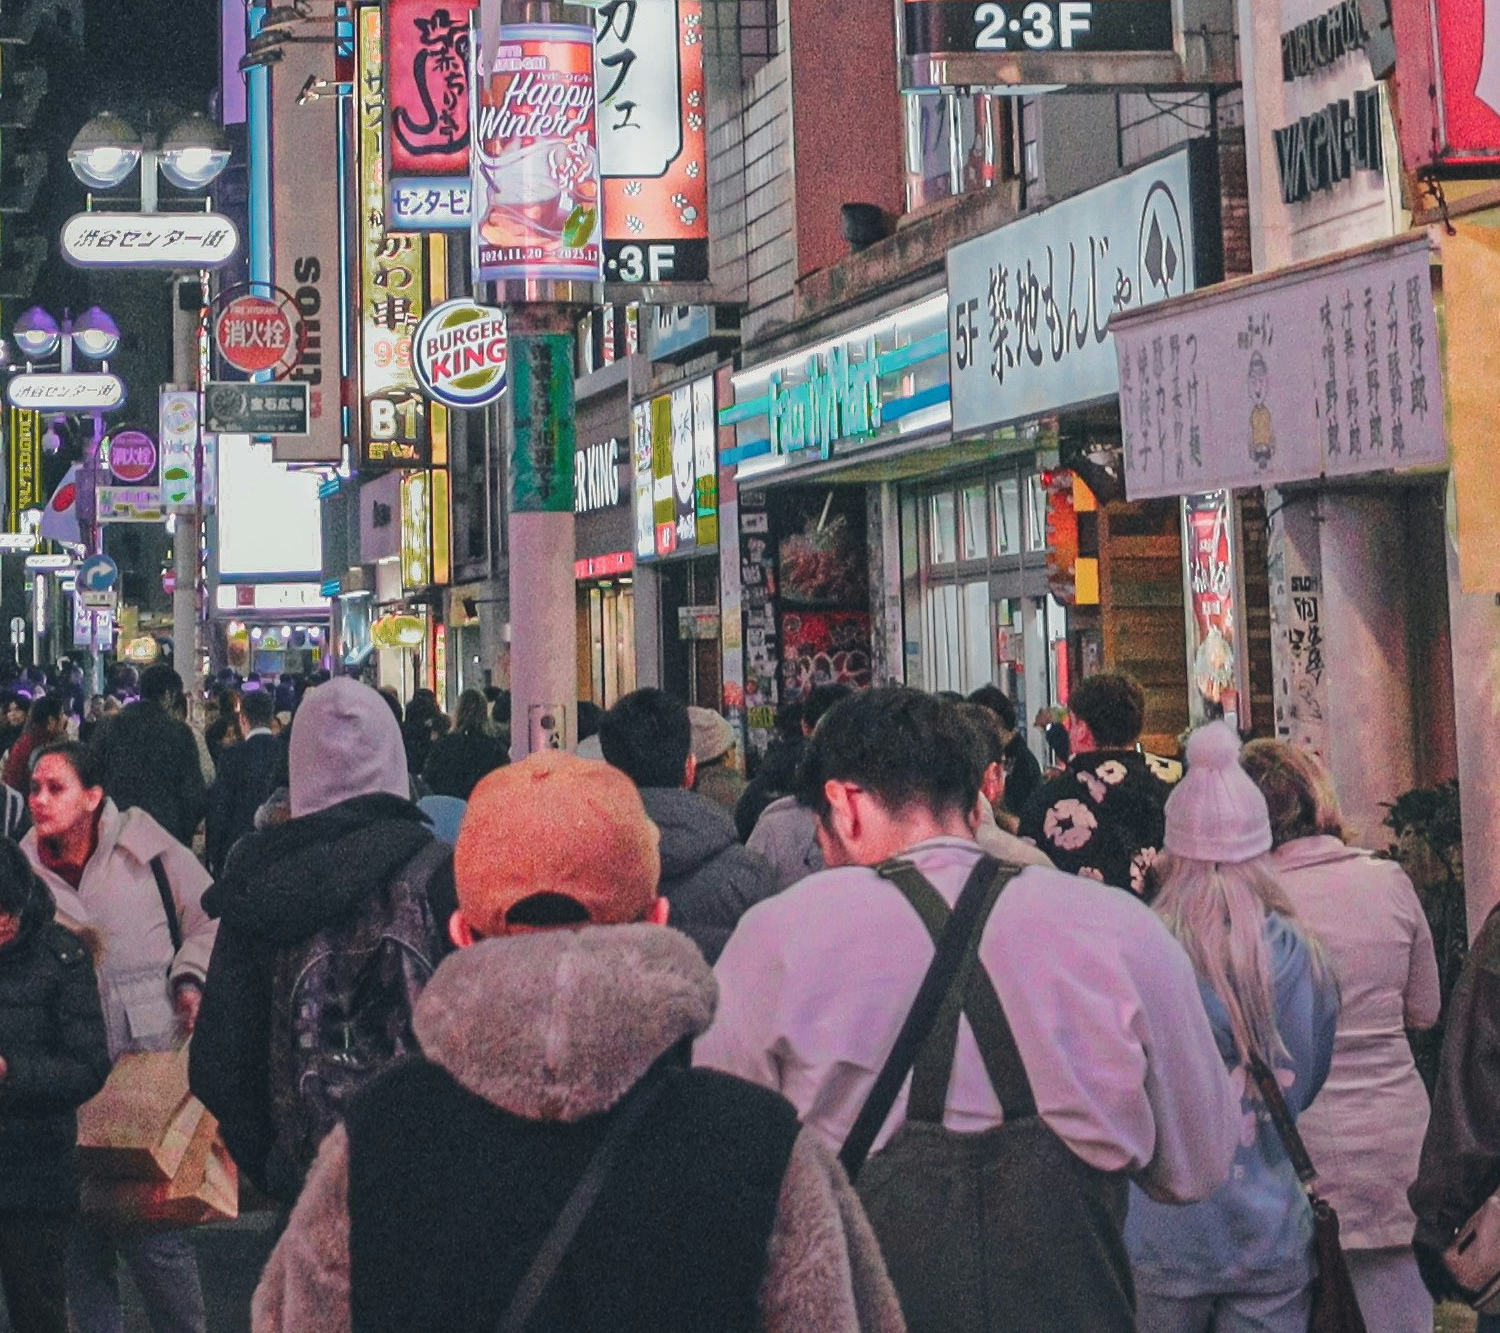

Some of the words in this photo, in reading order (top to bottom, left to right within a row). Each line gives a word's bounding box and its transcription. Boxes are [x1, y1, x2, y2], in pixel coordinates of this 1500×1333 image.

[479, 104, 578, 141] Winter
[502, 72, 594, 124] Happy
[73, 229, 227, 249] 渋谷センター街
[223, 318, 286, 349] 消火栓
[955, 297, 981, 372] 5F
[987, 237, 1133, 385] 築地もんじゃ
[426, 319, 504, 360] BURGER
[430, 337, 508, 386] KING
[369, 398, 417, 440] B1
[769, 337, 884, 459] FamilyMart
[587, 437, 620, 510] KING
